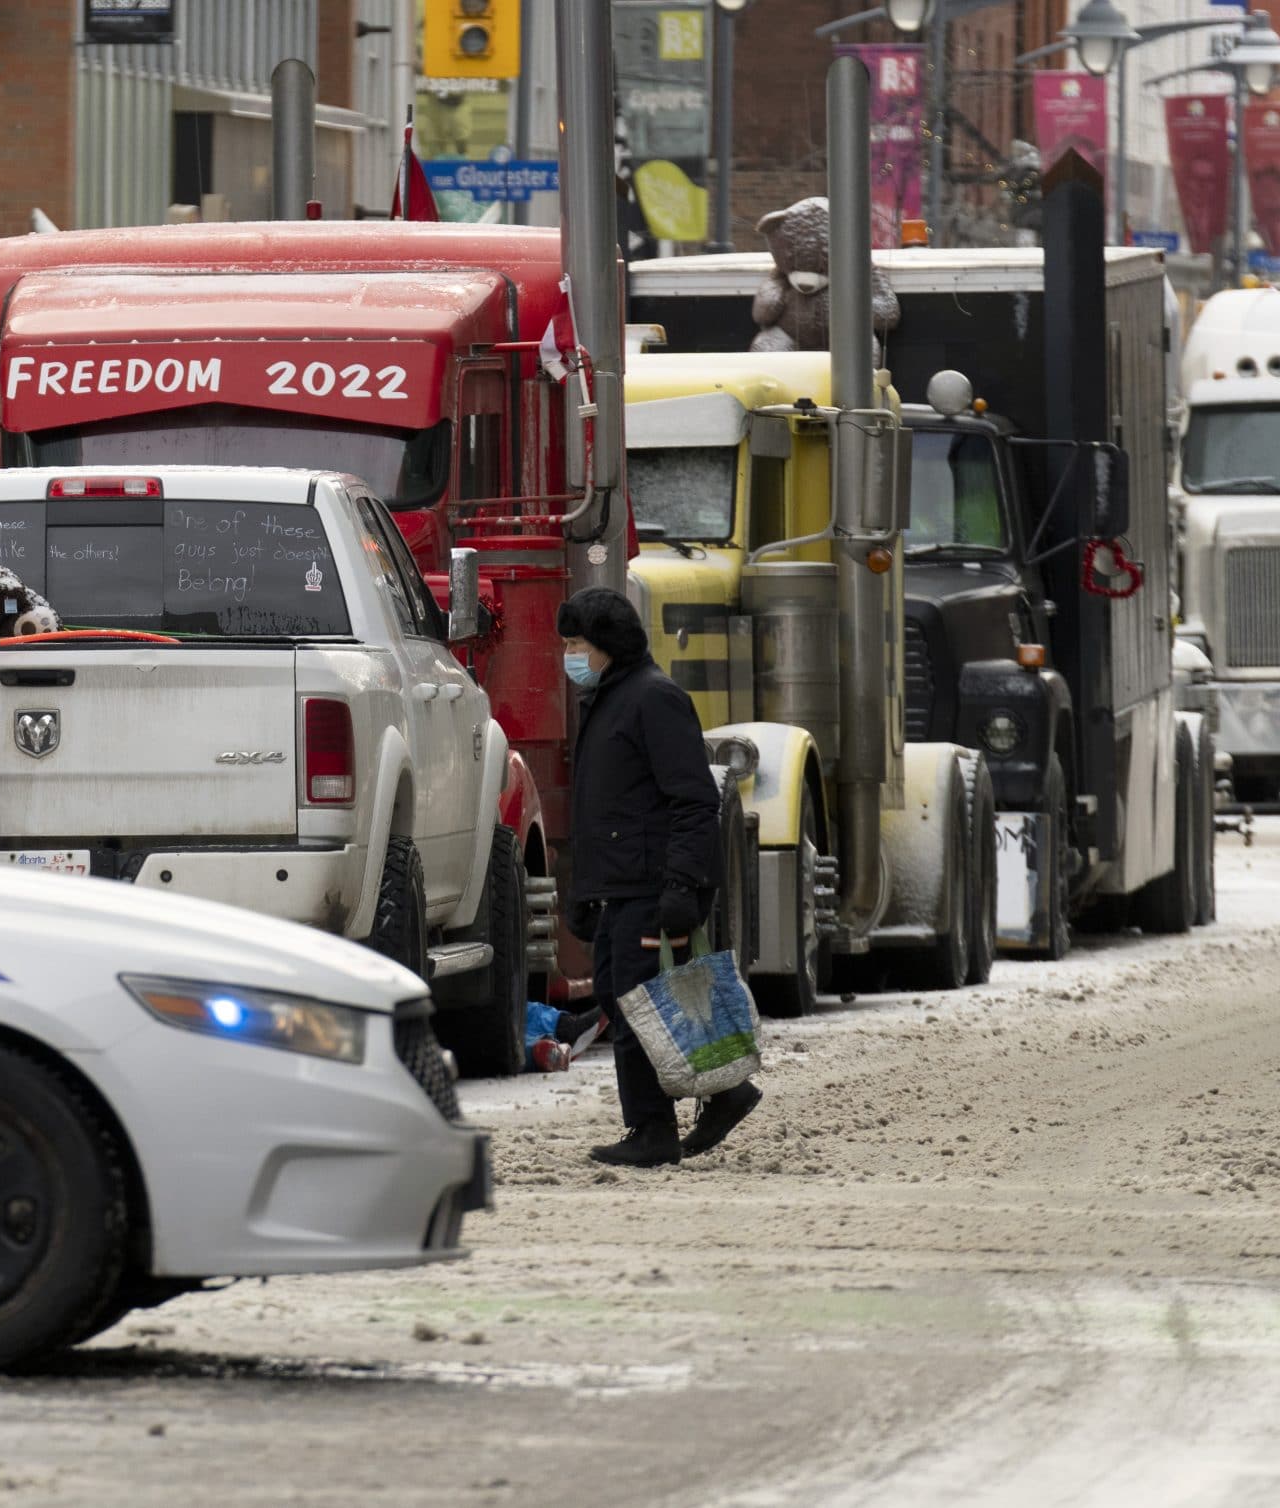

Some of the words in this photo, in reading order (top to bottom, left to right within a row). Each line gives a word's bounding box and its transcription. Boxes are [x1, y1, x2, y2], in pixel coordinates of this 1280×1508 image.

[456, 165, 548, 188] Gloucester
[7, 357, 222, 400] FREEDOM
[266, 361, 409, 400] 2022
[216, 510, 246, 535] of
[260, 514, 321, 539] these
[49, 544, 67, 559] the
[72, 542, 120, 561] others!
[174, 543, 217, 563] guys
[231, 538, 265, 565] just
[177, 563, 255, 602] Belong!
